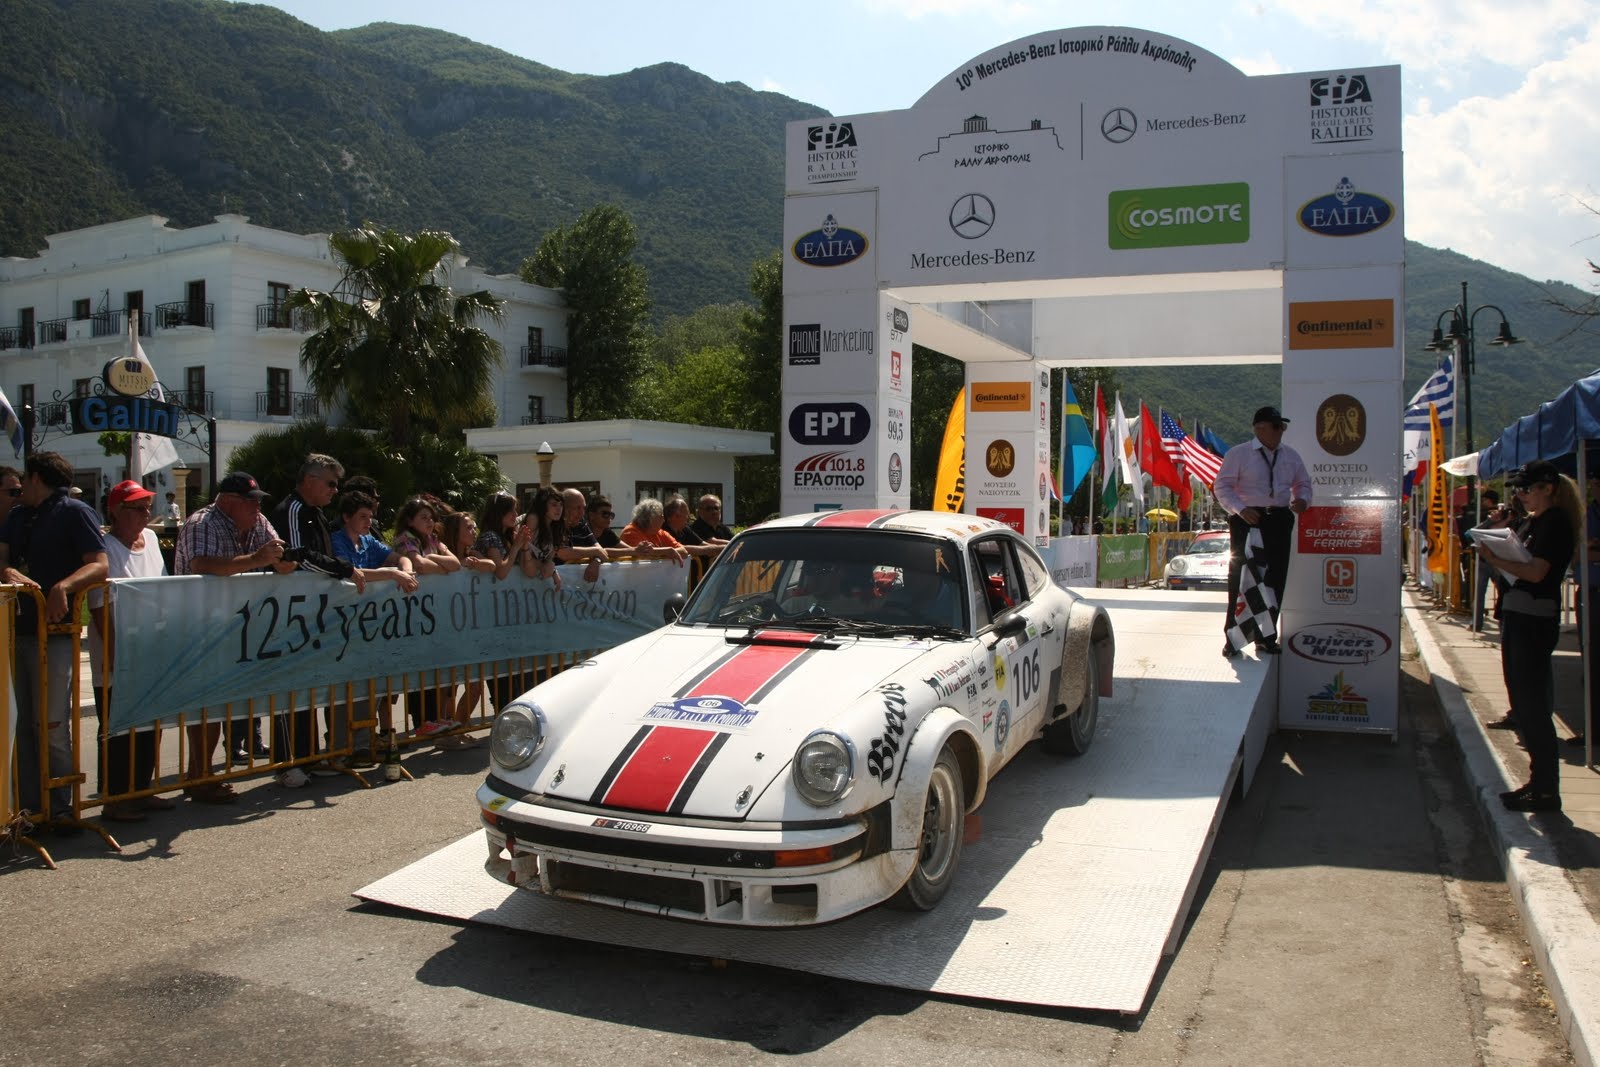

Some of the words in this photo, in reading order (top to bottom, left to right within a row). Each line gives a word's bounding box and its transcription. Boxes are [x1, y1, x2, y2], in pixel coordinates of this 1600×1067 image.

[975, 43, 1056, 80] Mercedes-Benz
[1059, 35, 1104, 55] Ιστορικό
[1106, 35, 1140, 54] Ράλλυ
[1141, 39, 1197, 73] Ακρόπολις
[1311, 105, 1374, 119] HISTORIC
[1146, 113, 1247, 132] Mercedes-Benz
[1310, 117, 1373, 127] REGULARITY
[1311, 124, 1374, 140] RALLIES
[808, 149, 858, 162] HISTORIC
[808, 170, 858, 180] CHAMPIONSHIP
[1129, 203, 1242, 228] COSMOTE
[1311, 206, 1380, 227] ΕΛΠΑ
[802, 240, 858, 259] ΕΛΠΑ
[910, 249, 1036, 269] Mercedes-Benz
[1297, 318, 1373, 335] Continental
[791, 329, 820, 354] PHONE
[823, 328, 874, 355] Marketing
[119, 374, 149, 386] MITSIS
[975, 393, 1019, 403] Continental
[80, 398, 179, 436] Galini
[830, 458, 865, 472] 101.8
[1312, 463, 1368, 473] ΜΟΥΣΕΙΟ
[1304, 528, 1373, 538] SUPERFAST
[1313, 538, 1362, 548] FERRIES
[333, 593, 436, 662] years
[450, 575, 481, 633] of
[493, 575, 638, 628] innovation
[1301, 634, 1375, 648] Drivers
[1311, 645, 1364, 657] News
[1013, 648, 1040, 708] 106
[613, 821, 650, 832] 216966
